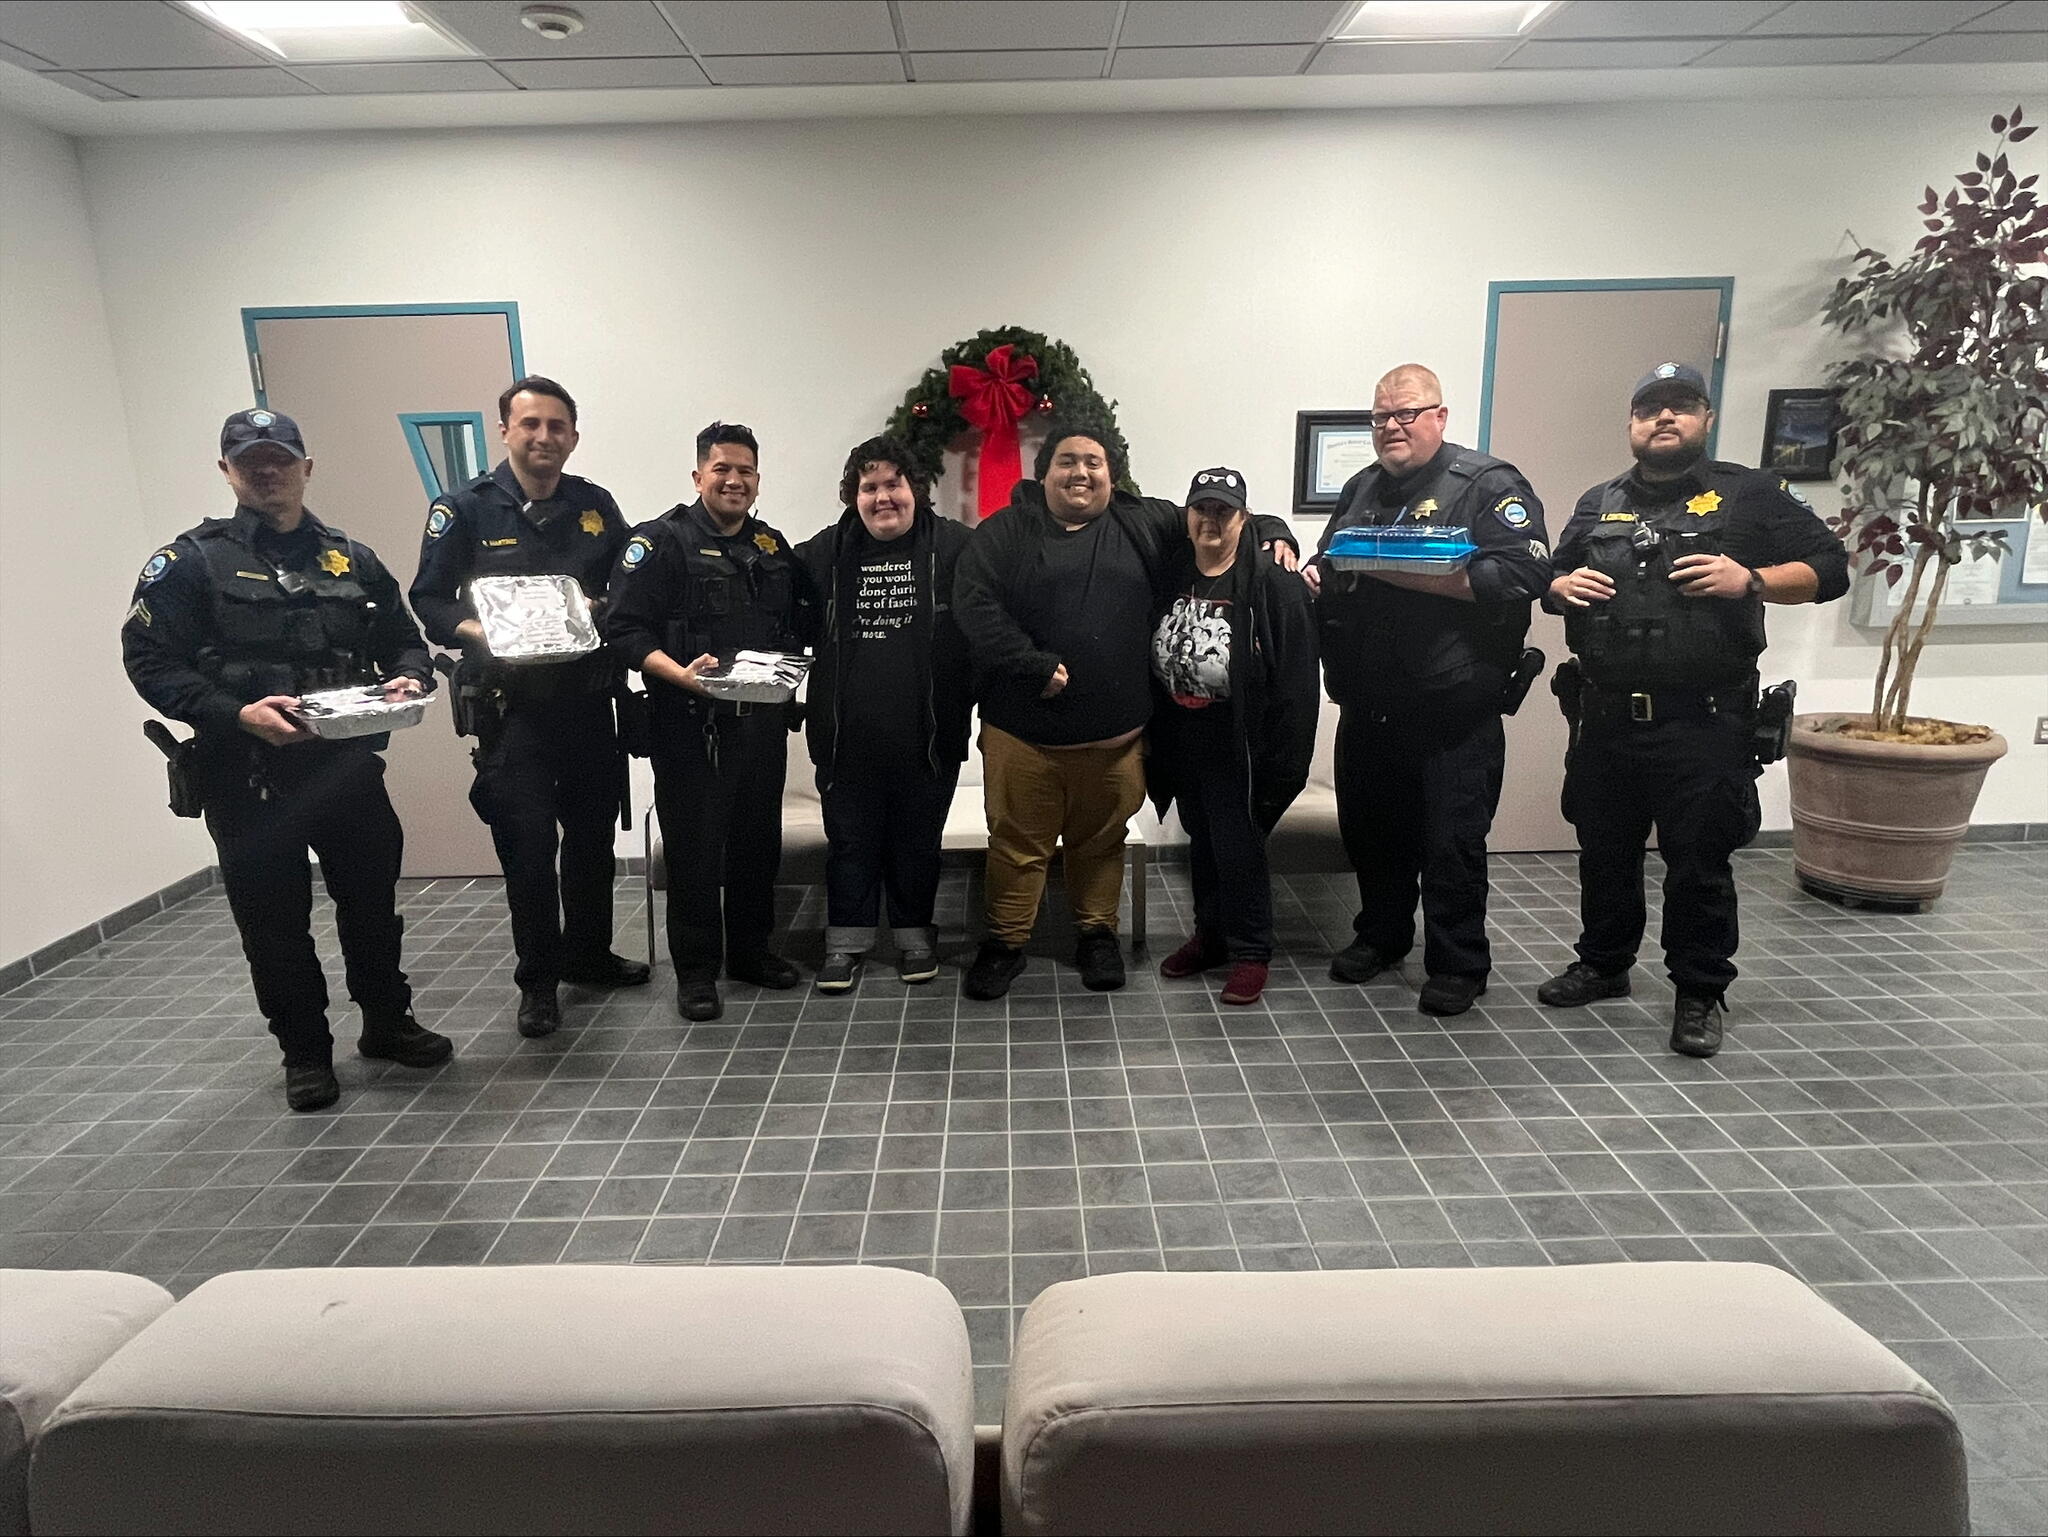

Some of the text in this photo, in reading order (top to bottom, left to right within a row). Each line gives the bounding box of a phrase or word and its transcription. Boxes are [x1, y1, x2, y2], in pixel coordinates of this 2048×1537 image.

[861, 560, 912, 572] wondered
[863, 576, 883, 587] you
[859, 586, 887, 597] done
[873, 597, 887, 609] of
[872, 615, 902, 628] doing
[903, 613, 912, 624] it
